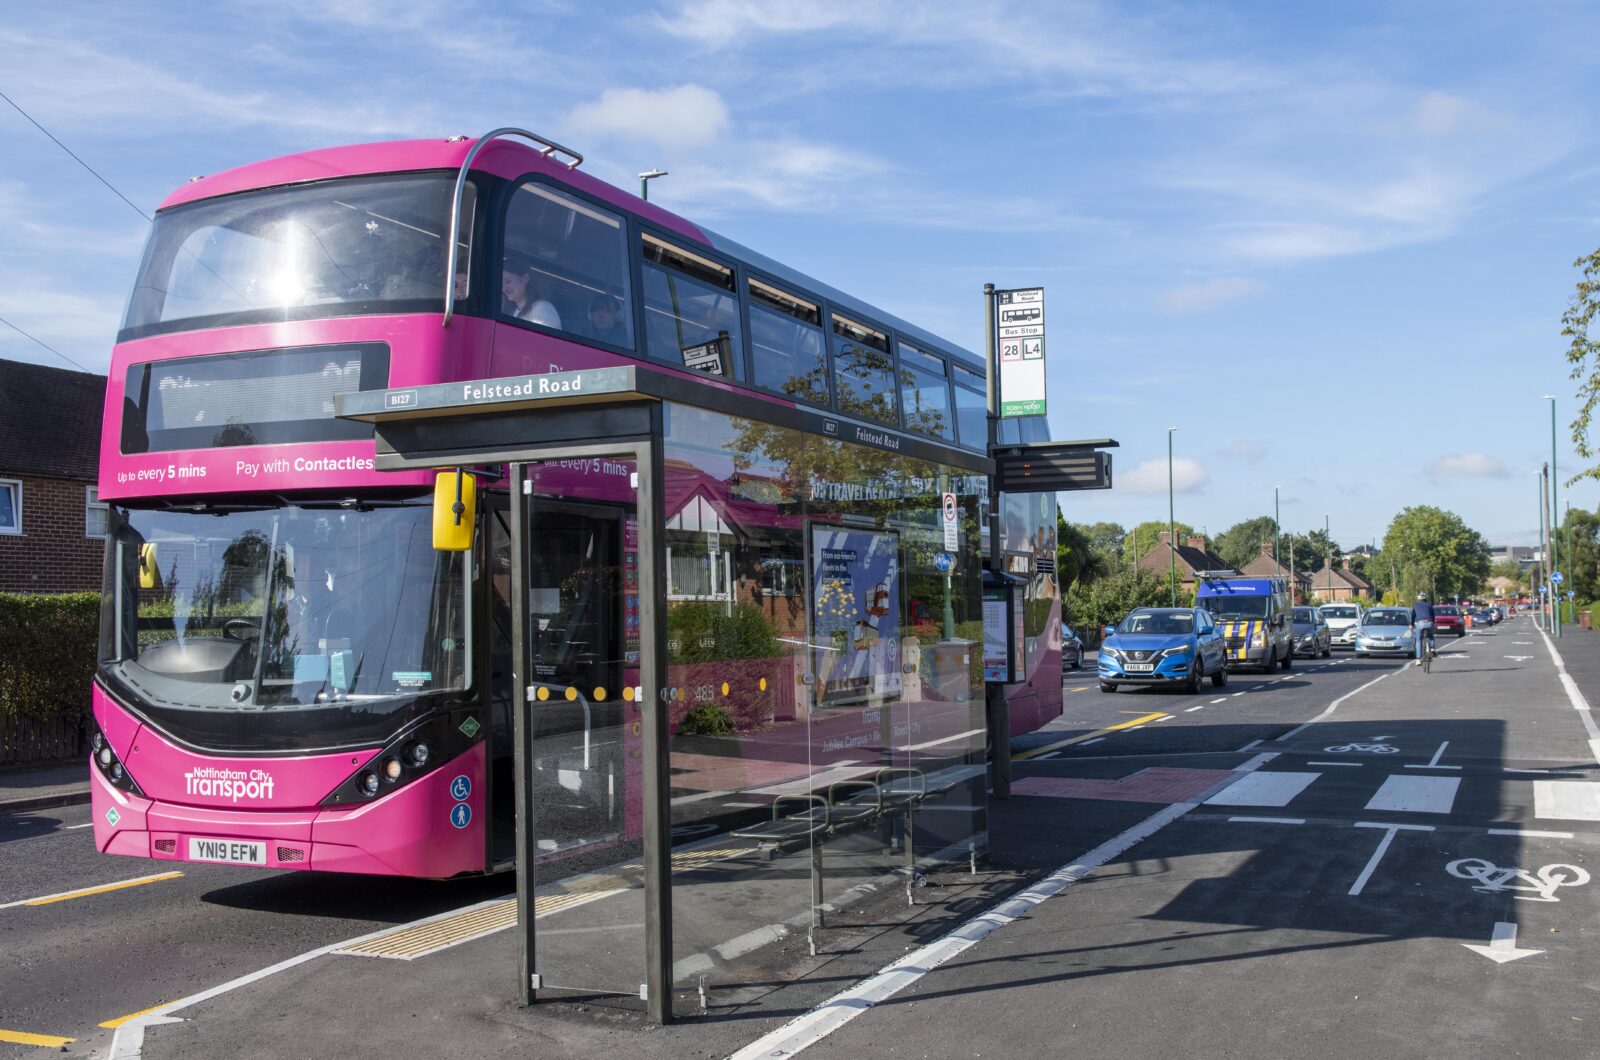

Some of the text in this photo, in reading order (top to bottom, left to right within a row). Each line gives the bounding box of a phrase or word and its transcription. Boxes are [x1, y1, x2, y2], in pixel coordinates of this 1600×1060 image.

[1004, 345, 1019, 356] 28
[1025, 343, 1041, 355] L4
[463, 379, 532, 401] Felstead
[538, 374, 582, 394] Road
[856, 427, 883, 446] Felstead
[884, 434, 900, 449] Road
[117, 464, 207, 484] Up to every 5 mins
[236, 456, 376, 478] Pay with Contactles
[559, 458, 628, 477] every 5 mins
[193, 767, 270, 785] Nottingham City
[184, 772, 275, 803] Transport
[198, 841, 258, 861] YN19 EFW
